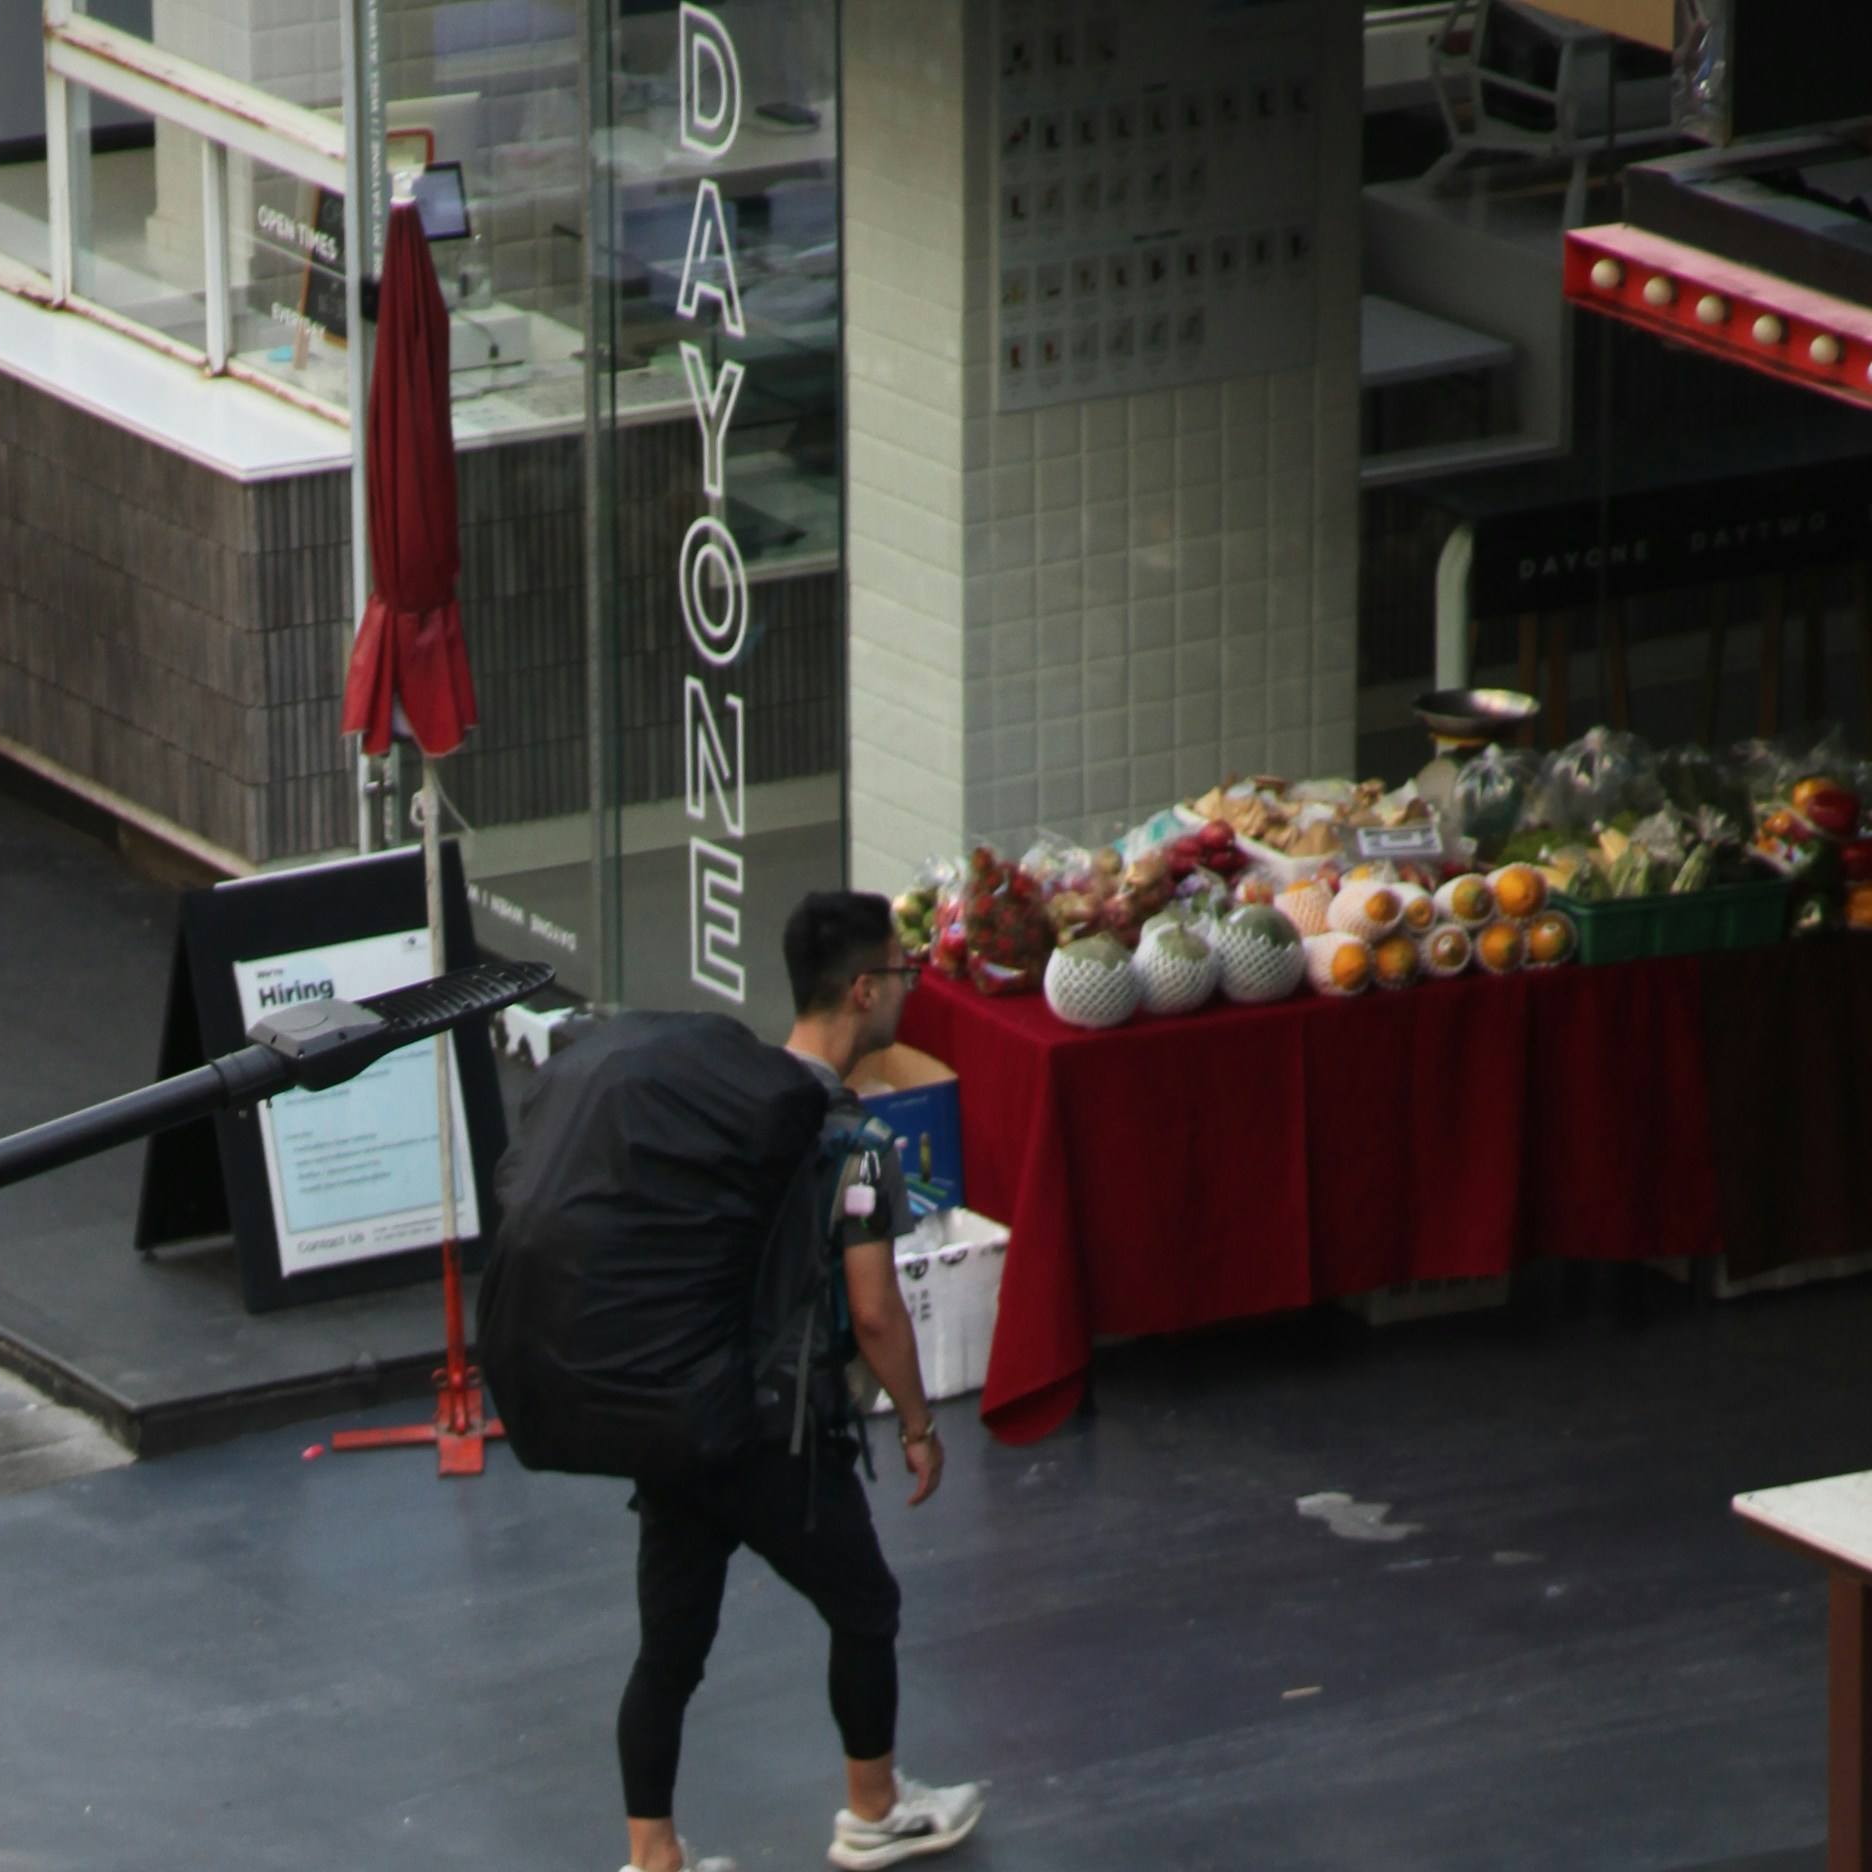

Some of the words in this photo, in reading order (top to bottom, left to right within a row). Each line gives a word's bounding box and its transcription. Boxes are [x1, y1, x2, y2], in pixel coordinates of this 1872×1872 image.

[257, 204, 295, 241] OPEN
[297, 222, 338, 262] TIMES
[677, 2, 749, 1003] DAYONE
[1518, 538, 1651, 582] DAYONE
[1689, 509, 1829, 553] DAYTWO
[258, 977, 336, 1009] Hiring
[297, 1234, 346, 1253] Contact
[347, 1230, 365, 1246] Us
